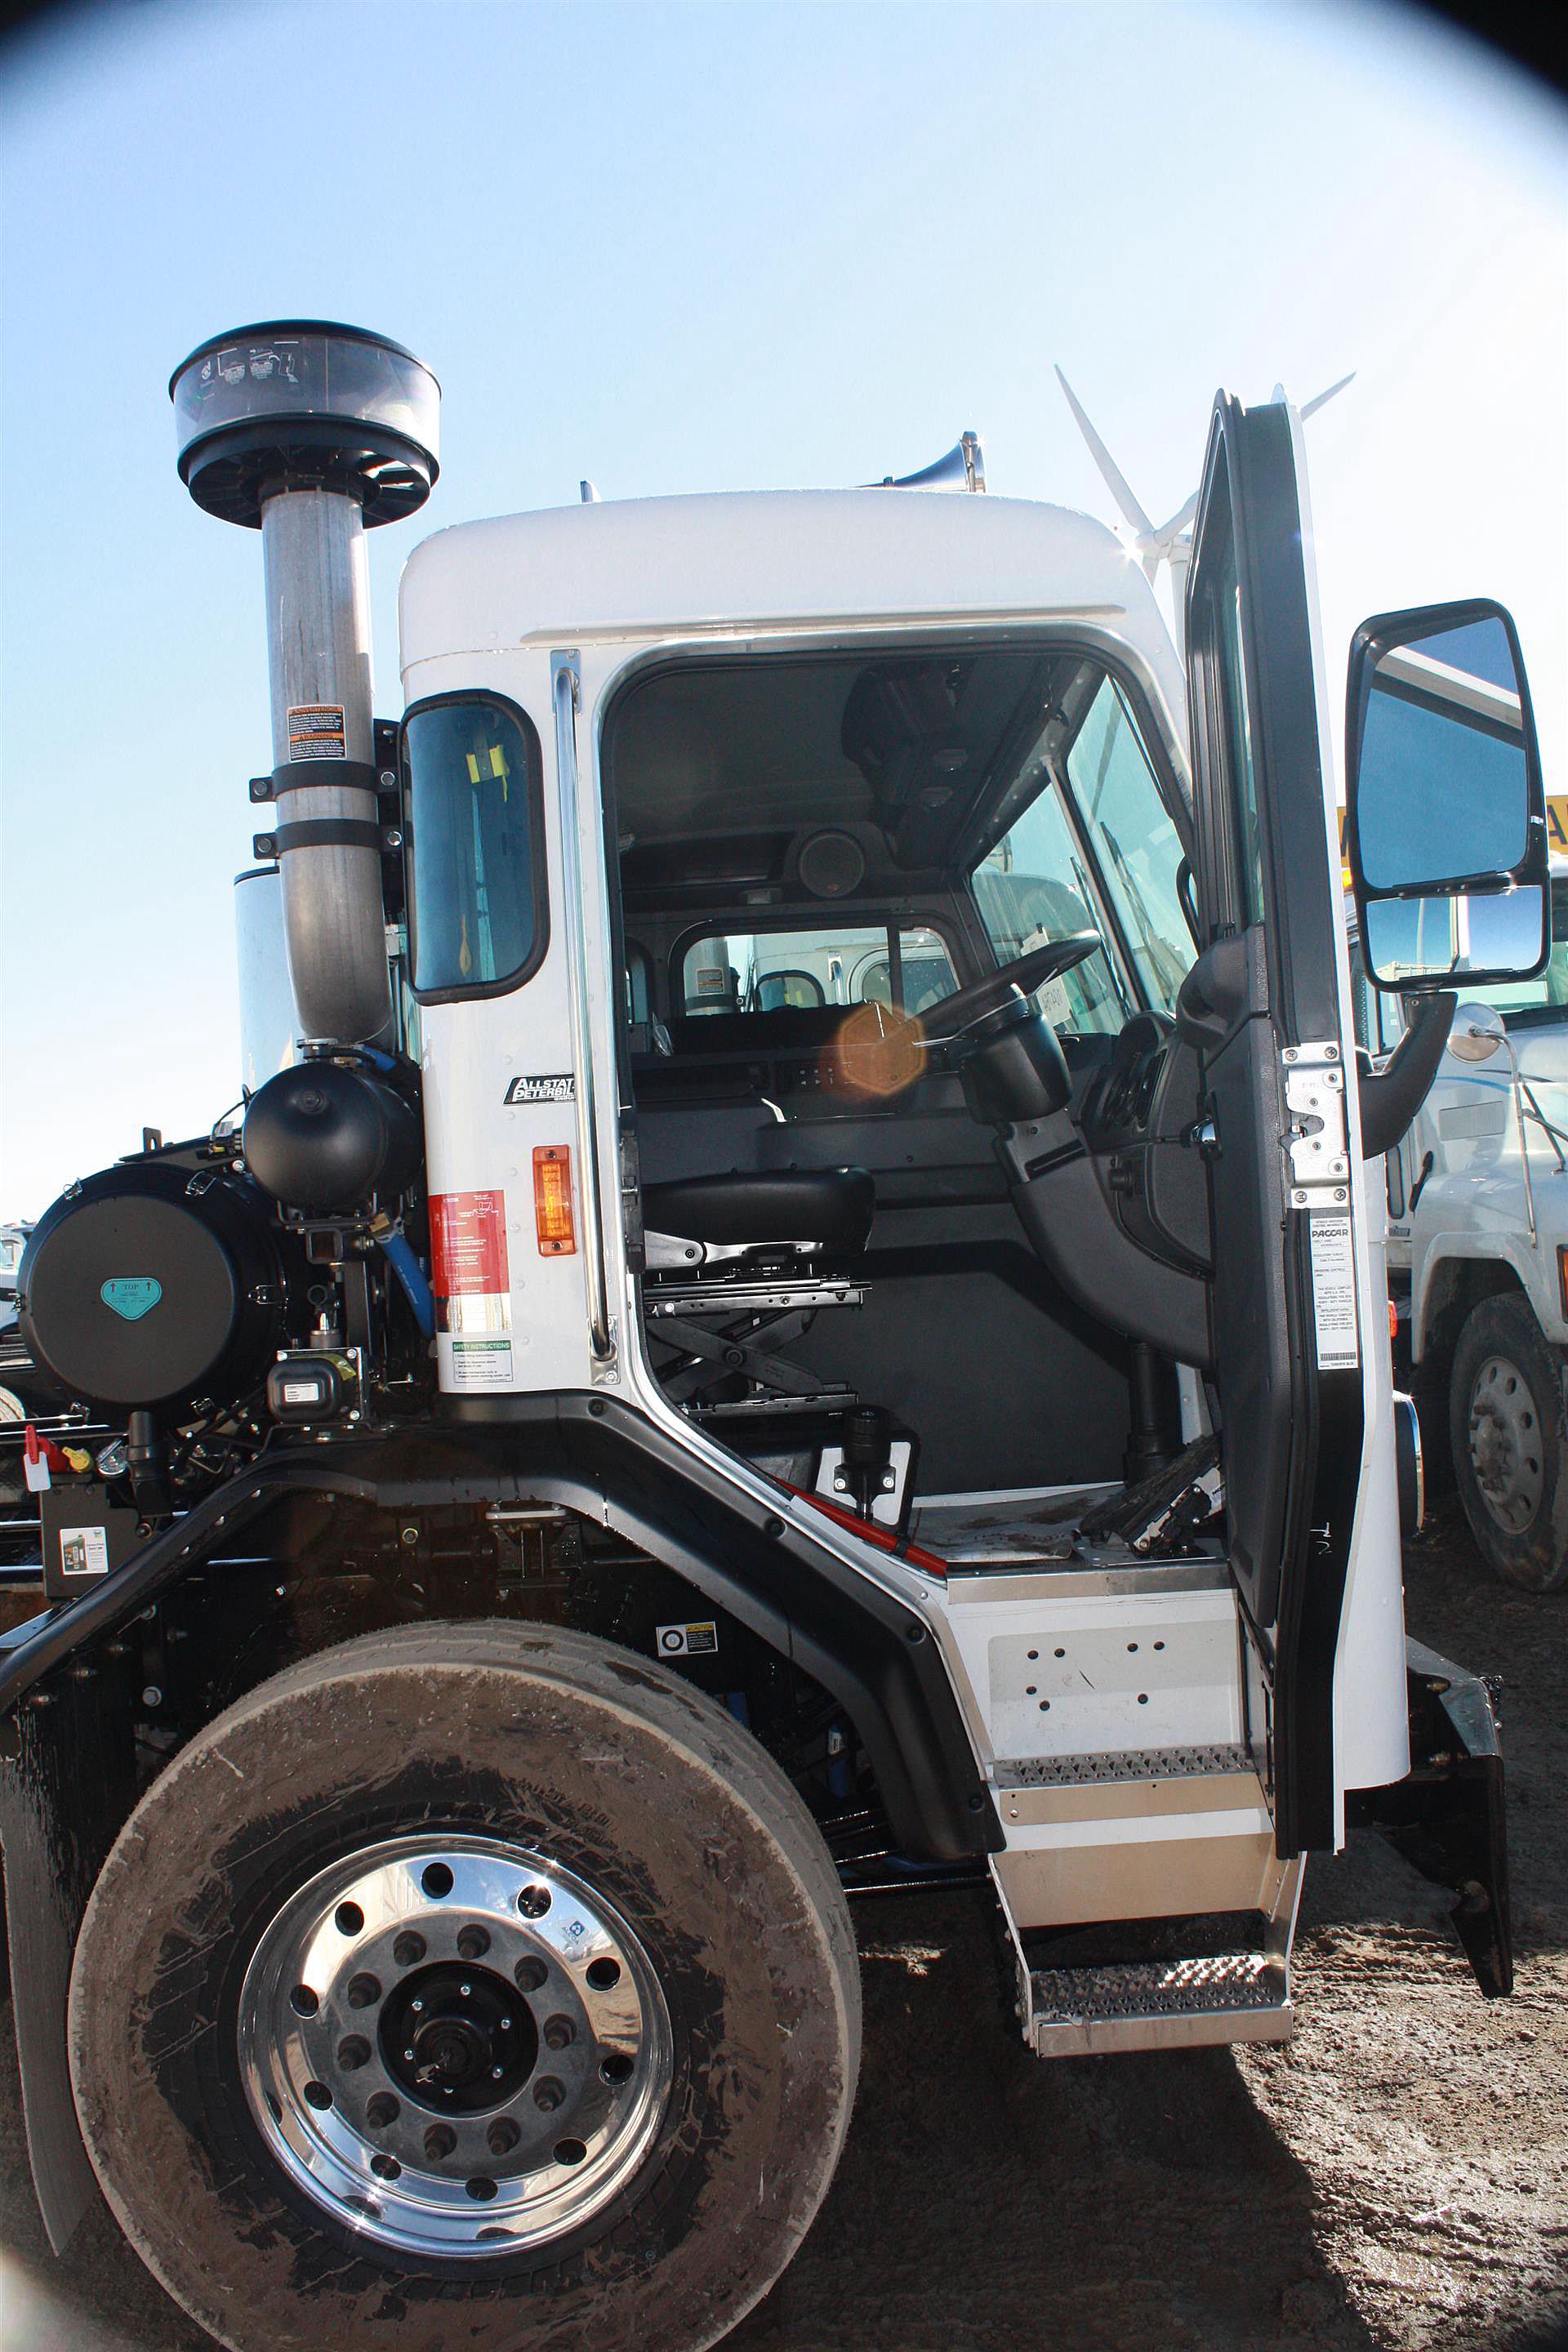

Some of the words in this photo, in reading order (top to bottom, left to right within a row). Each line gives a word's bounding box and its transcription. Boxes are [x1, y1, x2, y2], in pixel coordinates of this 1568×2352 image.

[515, 1077, 575, 1090] ALLSTAT
[512, 1086, 574, 1102] PETERBIL
[1312, 1228, 1349, 1238] PACCAR
